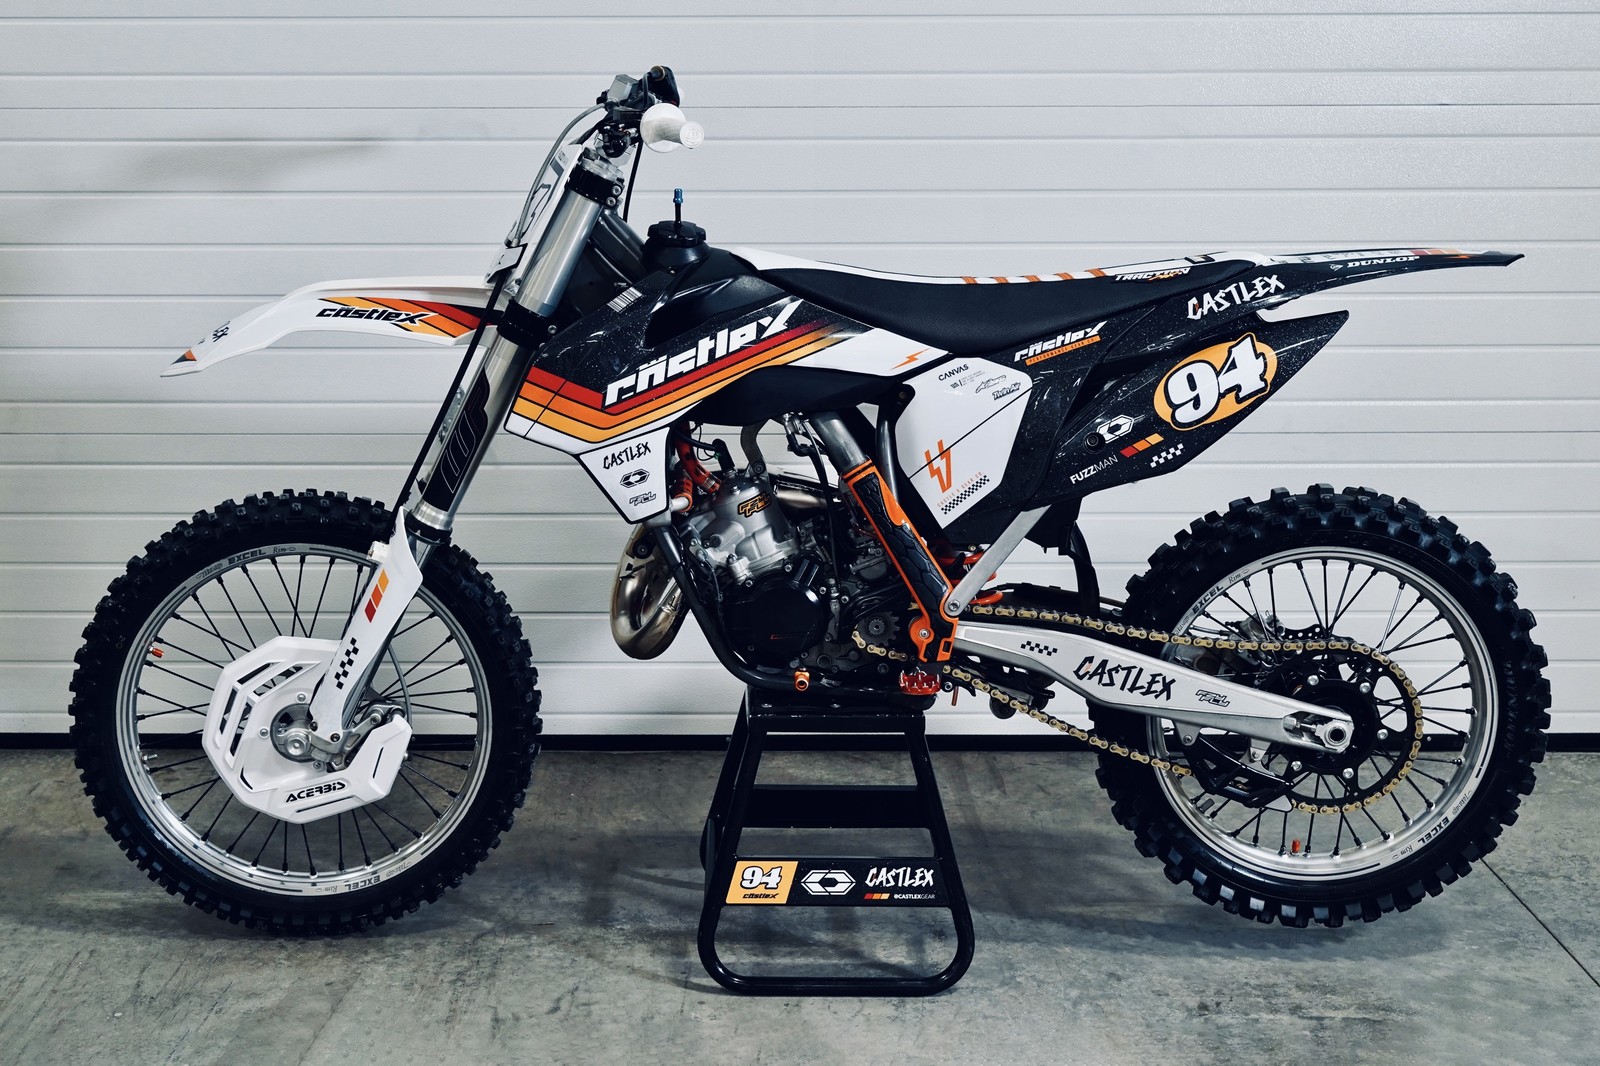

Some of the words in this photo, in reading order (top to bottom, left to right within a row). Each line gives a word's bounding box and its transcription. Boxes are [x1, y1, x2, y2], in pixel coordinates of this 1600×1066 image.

[1346, 255, 1420, 268] DUNLOP
[1186, 274, 1286, 320] CASTLEX
[938, 363, 969, 381] CANVAS
[1164, 334, 1269, 427] 94
[602, 441, 651, 470] CASTLEX
[1069, 453, 1119, 484] FUZZMAN
[228, 549, 266, 565] EXCEL
[1191, 585, 1224, 614] EXCEL
[1073, 655, 1176, 702] CASTLEX
[285, 781, 346, 803] ACERBIS
[1417, 816, 1450, 844] EXCEL
[344, 874, 381, 891] EXCEL
[740, 865, 782, 890] 94
[864, 866, 935, 887] CASTLEX
